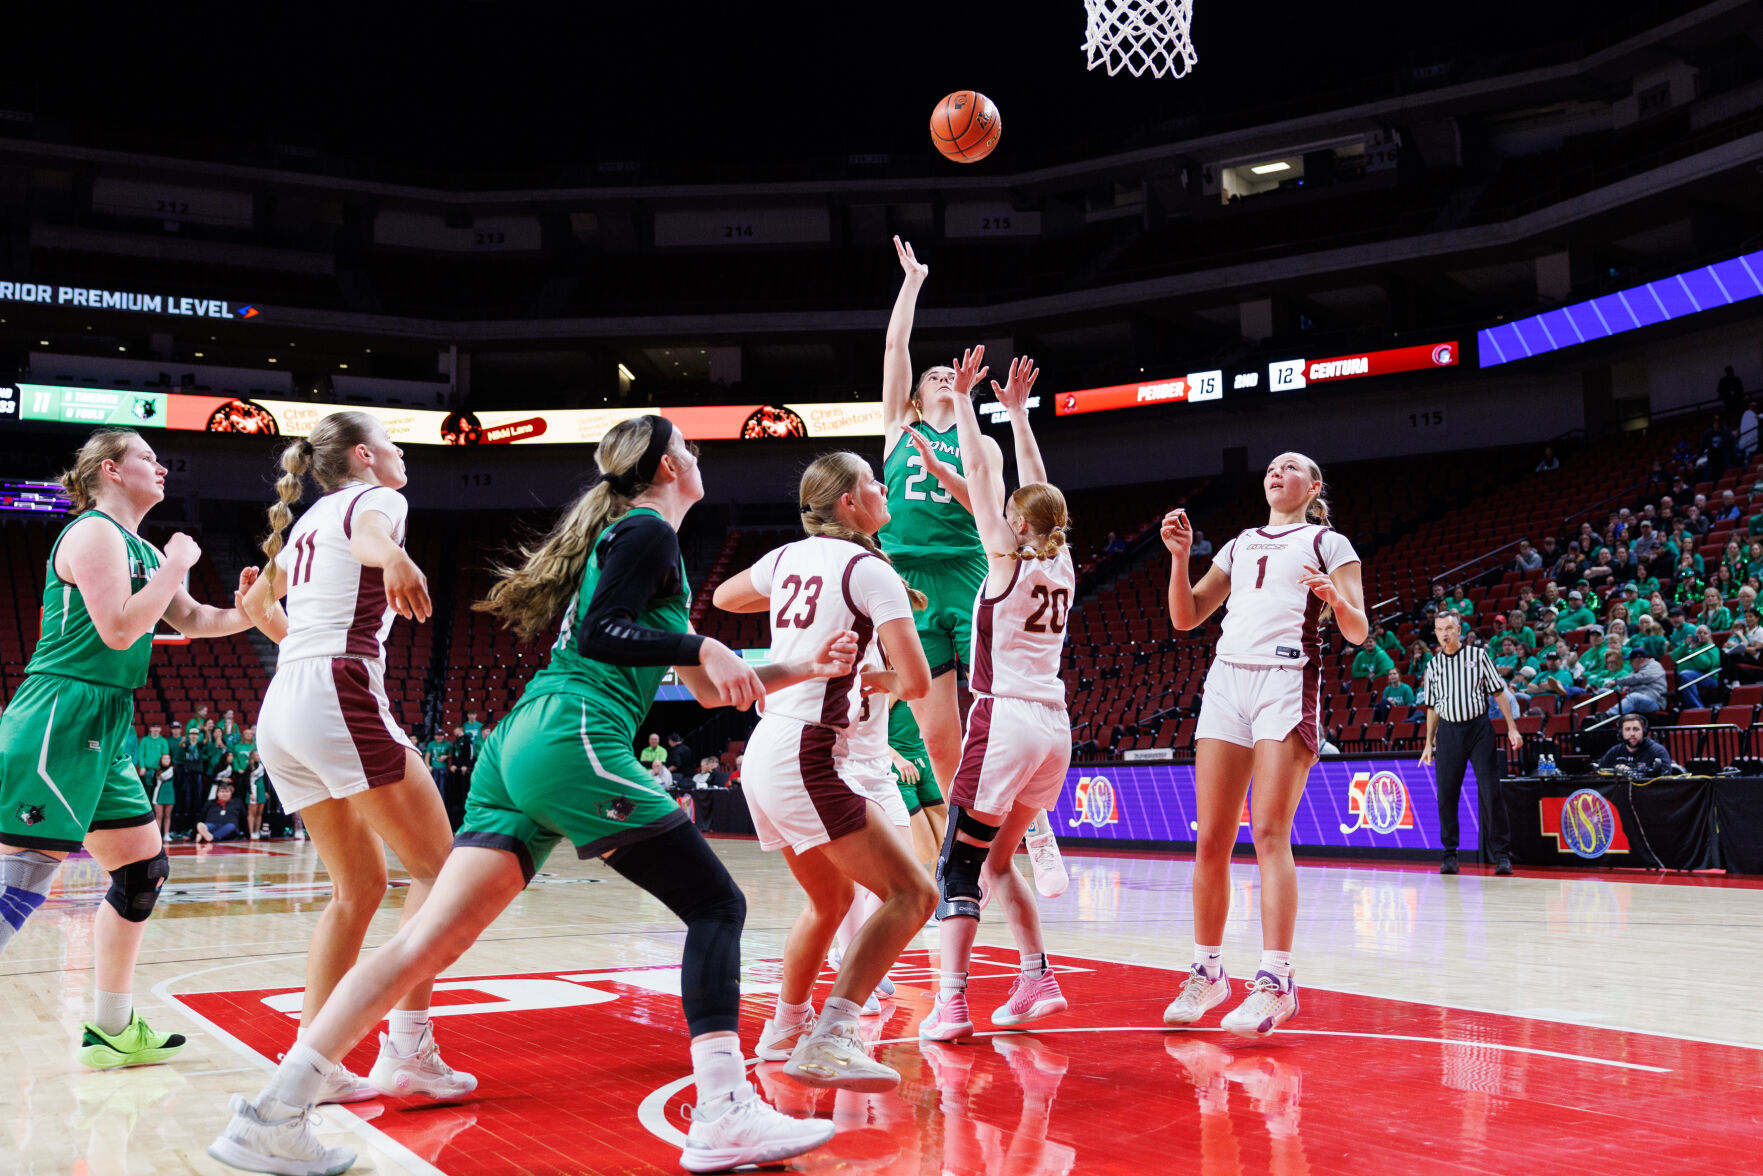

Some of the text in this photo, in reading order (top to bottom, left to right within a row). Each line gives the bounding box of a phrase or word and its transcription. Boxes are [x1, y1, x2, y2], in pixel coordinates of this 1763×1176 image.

[1365, 151, 1396, 166] 216
[157, 200, 189, 214] 212
[724, 225, 753, 238] 214
[981, 217, 1011, 230] 215
[476, 232, 505, 244] 213
[58, 286, 162, 313] PREMIUM
[167, 297, 234, 319] LEVEL
[1278, 367, 1294, 384] 12
[1309, 357, 1369, 380] CENTURA
[1137, 381, 1184, 402] PENDER
[1199, 379, 1216, 395] 15
[282, 408, 319, 421] Chris
[810, 407, 843, 421] Chris
[1408, 411, 1442, 427] 115
[461, 473, 492, 487] 113
[904, 454, 958, 504] 23
[292, 529, 319, 587] 11
[1255, 555, 1269, 589] 1
[776, 574, 824, 630] 23
[1024, 584, 1068, 634] 20
